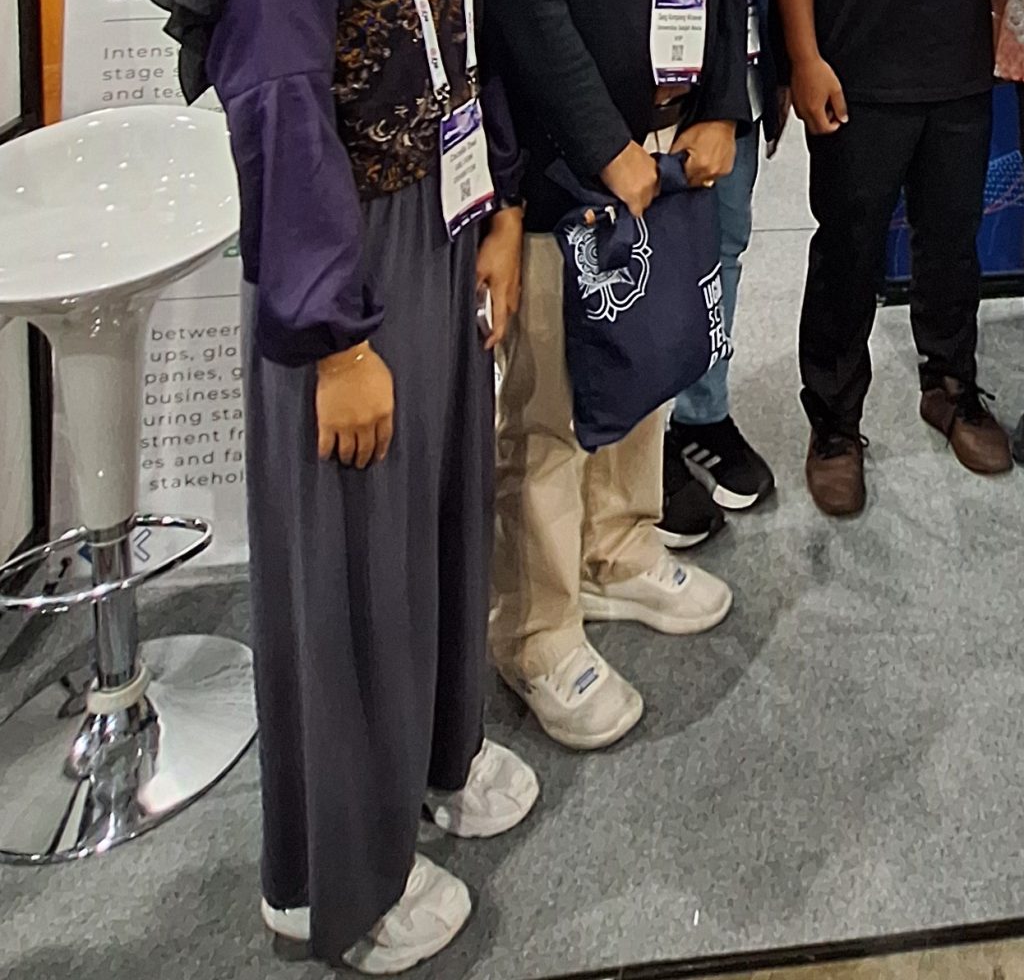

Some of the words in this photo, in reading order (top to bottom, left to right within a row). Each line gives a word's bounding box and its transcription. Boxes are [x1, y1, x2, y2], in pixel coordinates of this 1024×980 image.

[103, 68, 164, 81] stage
[102, 87, 144, 102] and
[150, 350, 195, 364] ups,
[145, 387, 242, 406] business
[143, 411, 202, 427] uring
[140, 432, 220, 449] stment
[174, 451, 215, 467] and
